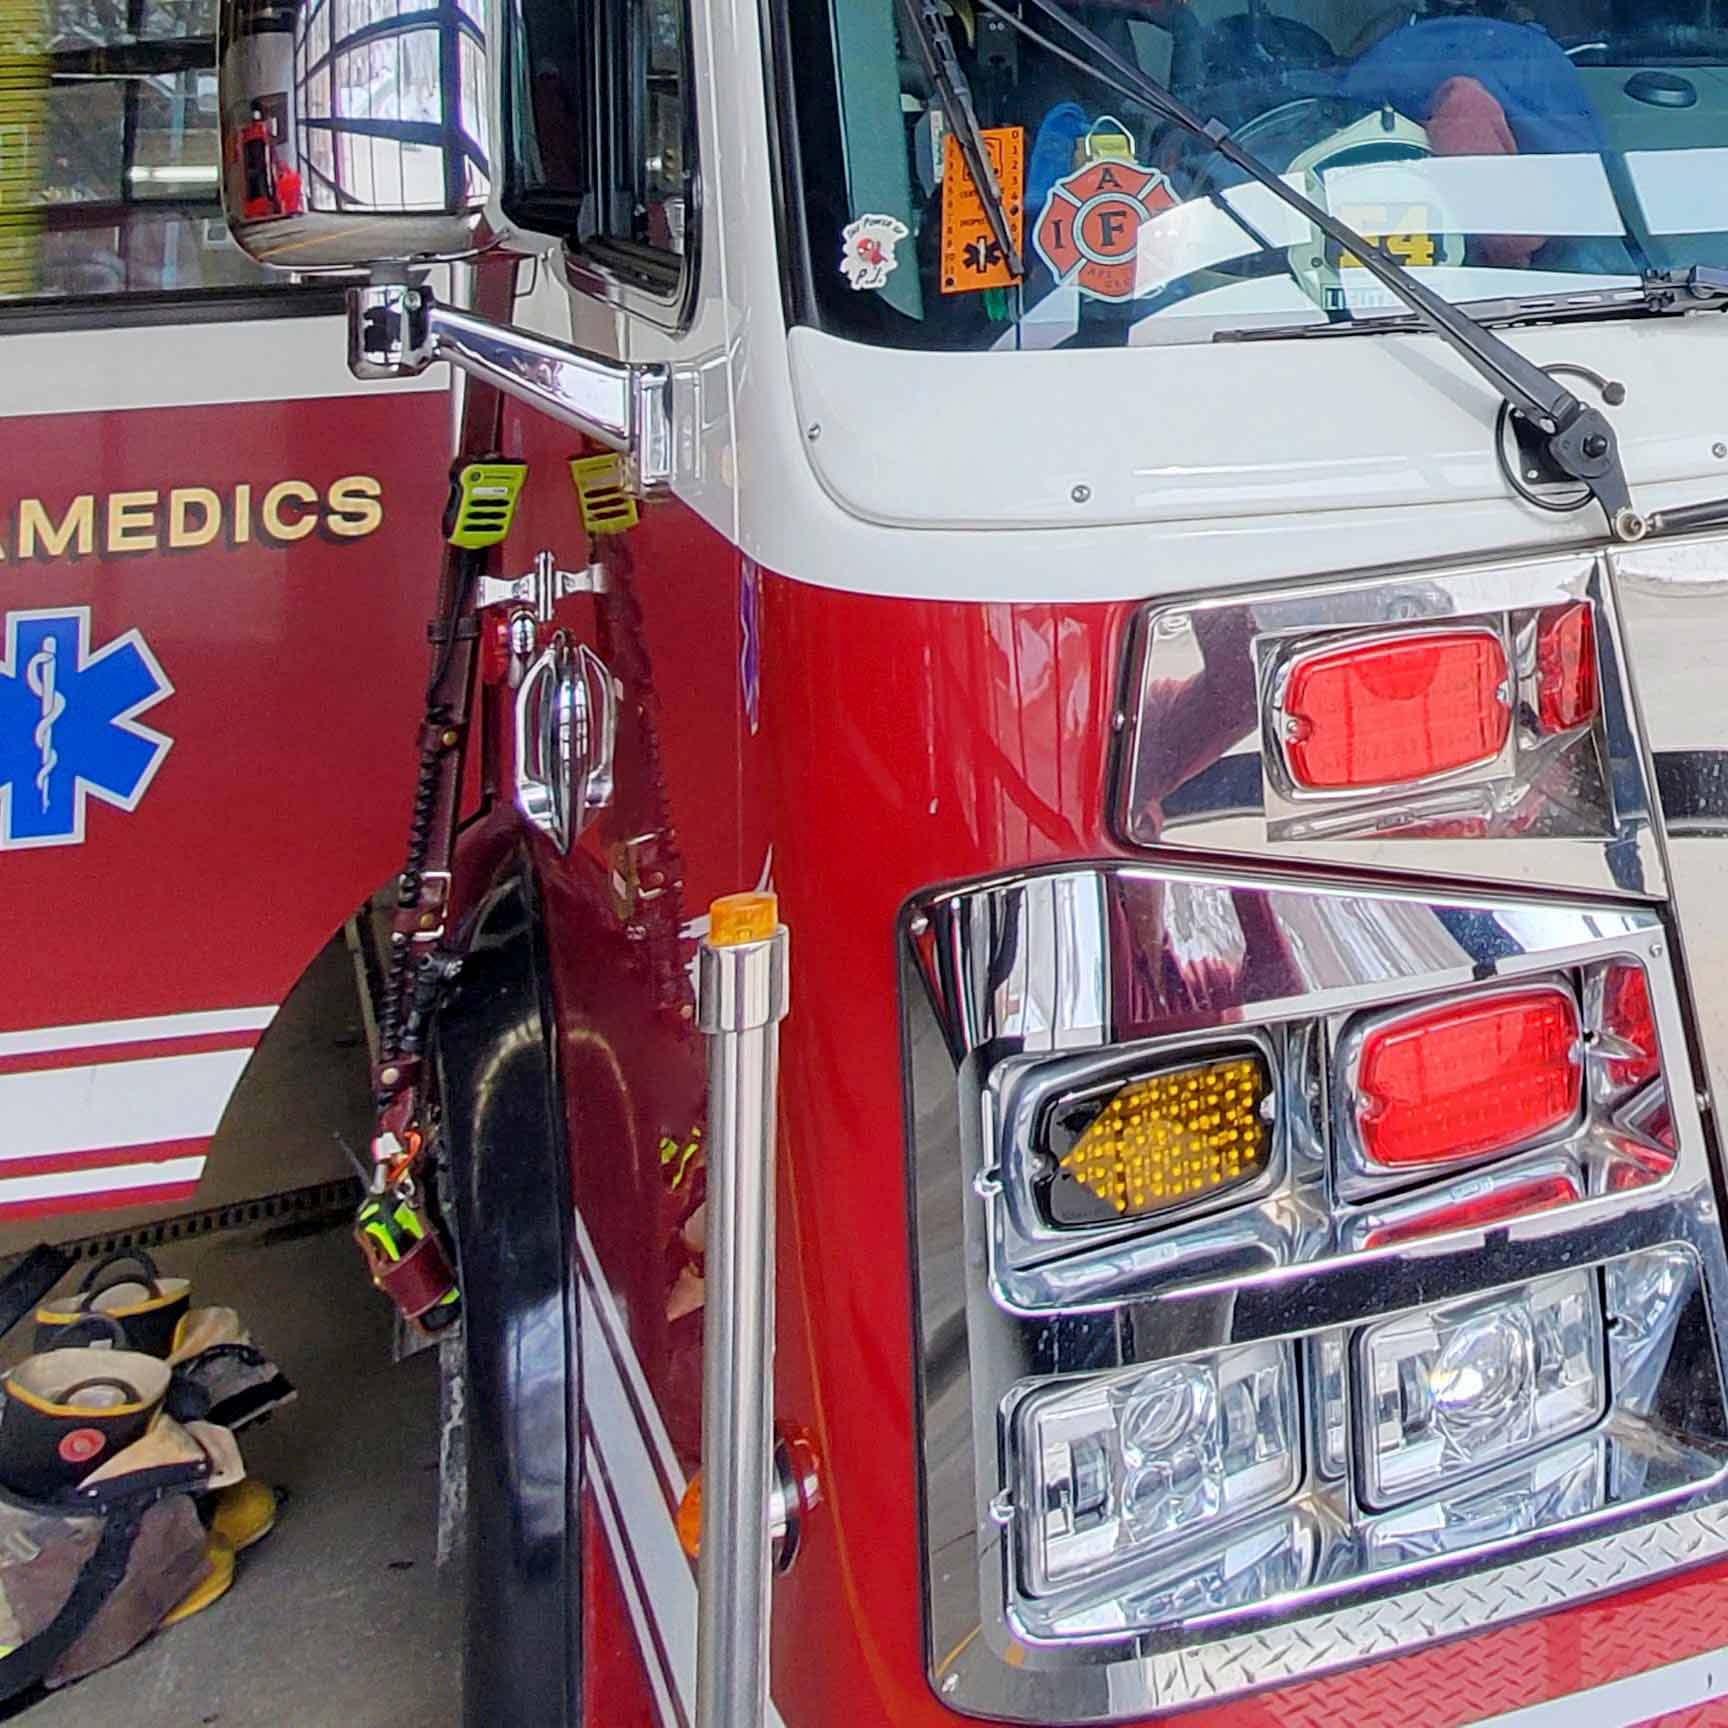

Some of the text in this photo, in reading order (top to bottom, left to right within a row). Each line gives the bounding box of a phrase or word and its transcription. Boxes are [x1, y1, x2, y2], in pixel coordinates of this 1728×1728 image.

[1095, 168, 1122, 190] A
[1052, 219, 1064, 250] I
[1098, 210, 1127, 248] F
[0, 475, 384, 562] MEDICS
